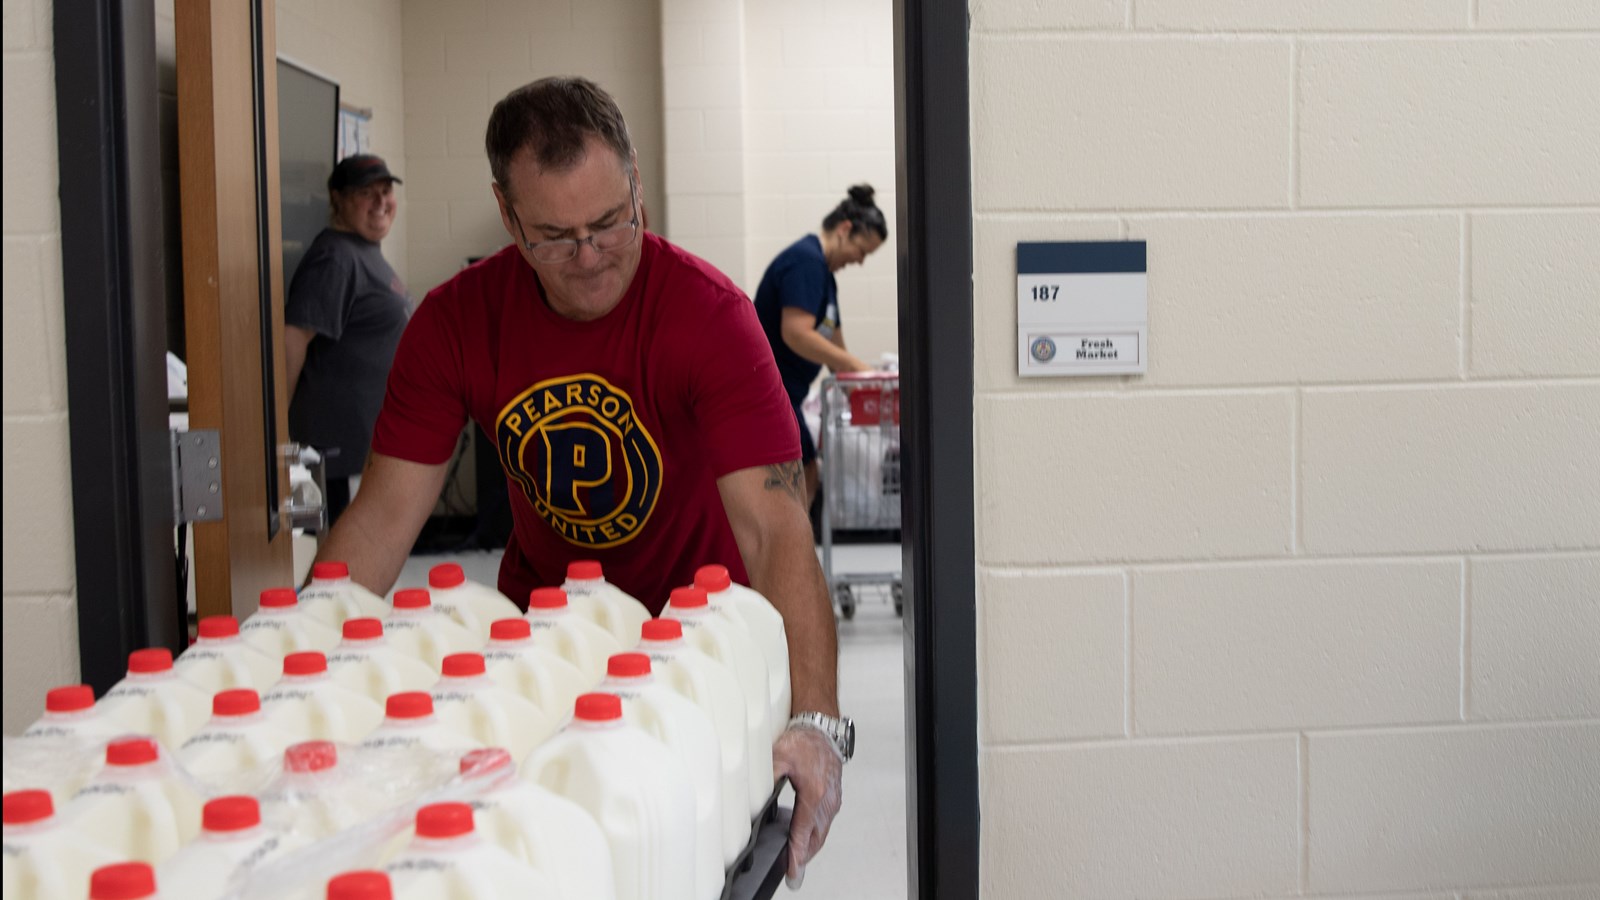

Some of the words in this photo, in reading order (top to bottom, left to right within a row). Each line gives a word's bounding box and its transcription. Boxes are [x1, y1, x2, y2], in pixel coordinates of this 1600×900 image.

[1031, 285, 1060, 301] 187
[1076, 349, 1118, 360] Market
[1081, 338, 1113, 348] Fresh
[505, 383, 633, 437] PEARSON
[540, 421, 612, 516] P
[535, 500, 638, 543] UNITED
